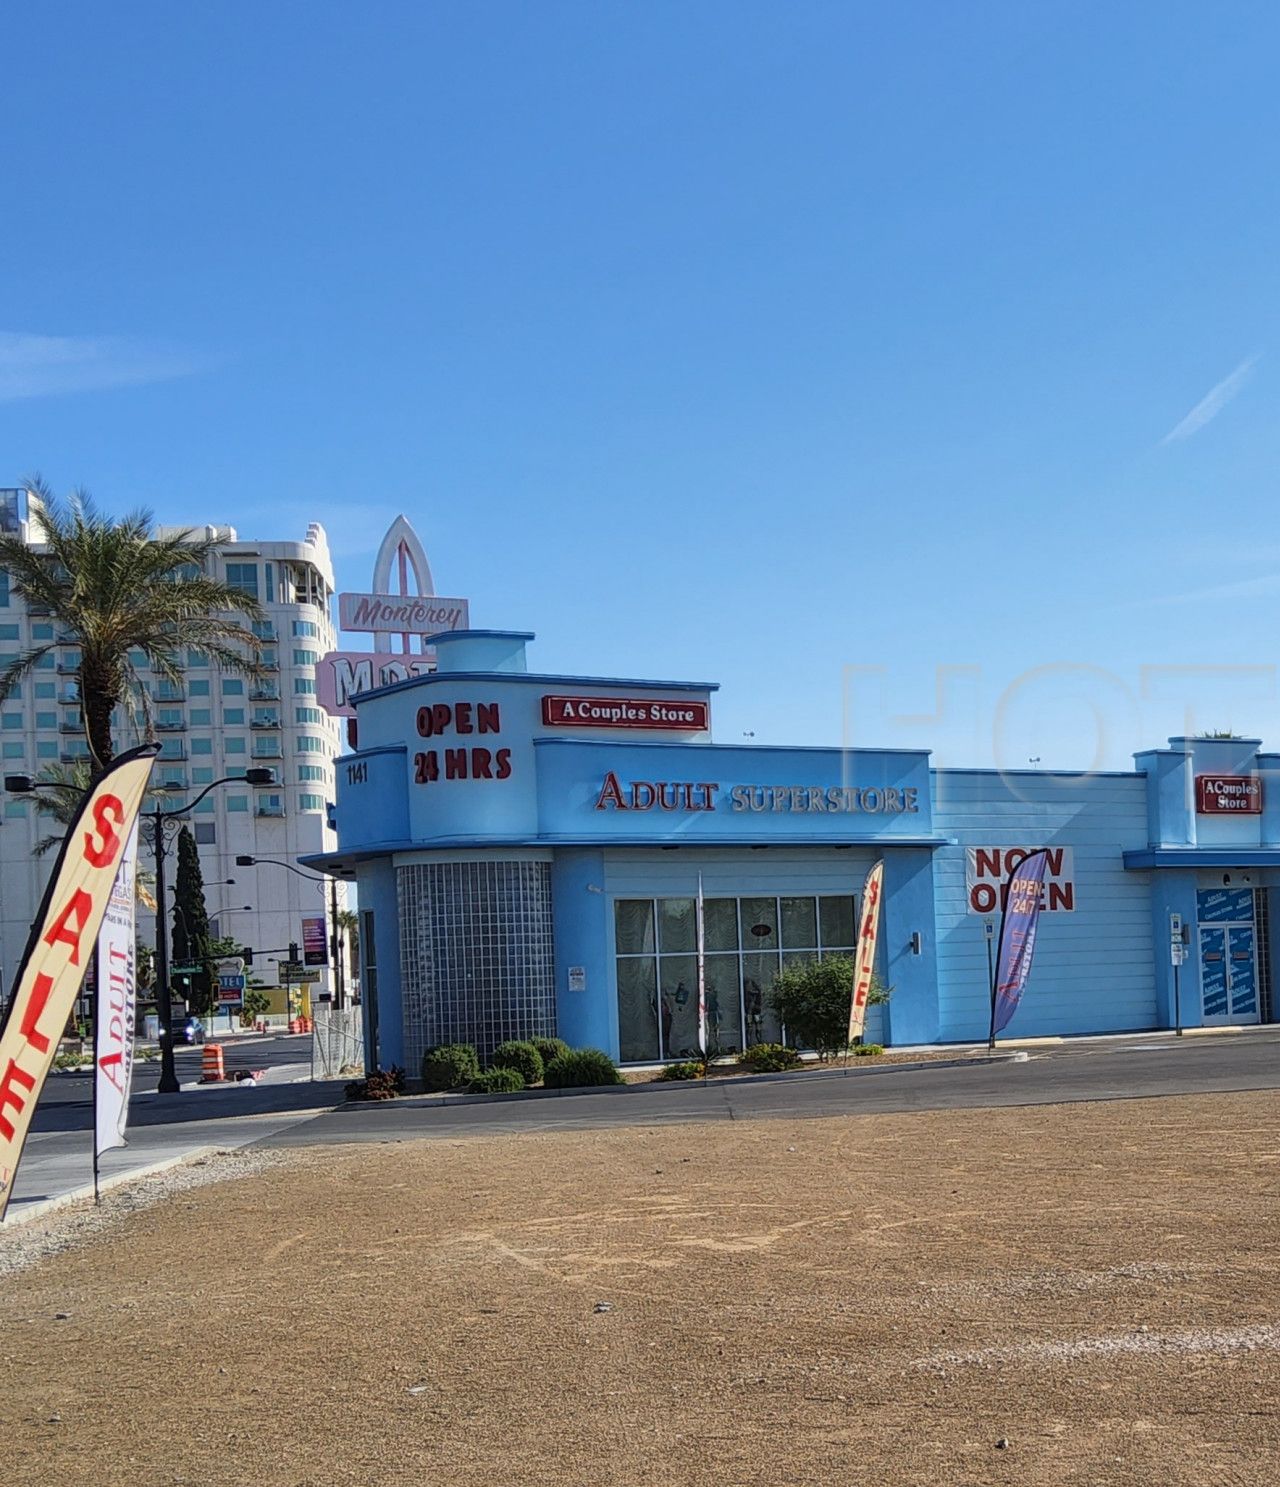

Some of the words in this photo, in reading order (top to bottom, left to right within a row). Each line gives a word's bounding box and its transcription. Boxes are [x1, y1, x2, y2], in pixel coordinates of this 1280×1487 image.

[353, 598, 462, 630] Monterey
[415, 702, 501, 738] OPEN
[562, 702, 576, 717] A
[578, 702, 646, 723] Couples
[650, 705, 695, 722] Store
[347, 762, 367, 785] 1141
[414, 750, 439, 784] 24
[445, 746, 511, 781] HRS
[595, 769, 719, 812] ADULT
[731, 785, 919, 814] SUPERSTORE
[1205, 781, 1214, 793] A
[1214, 781, 1259, 797] Couples
[1217, 795, 1248, 809] Store
[1010, 878, 1043, 897] OPEN
[0, 793, 124, 1143] SALE
